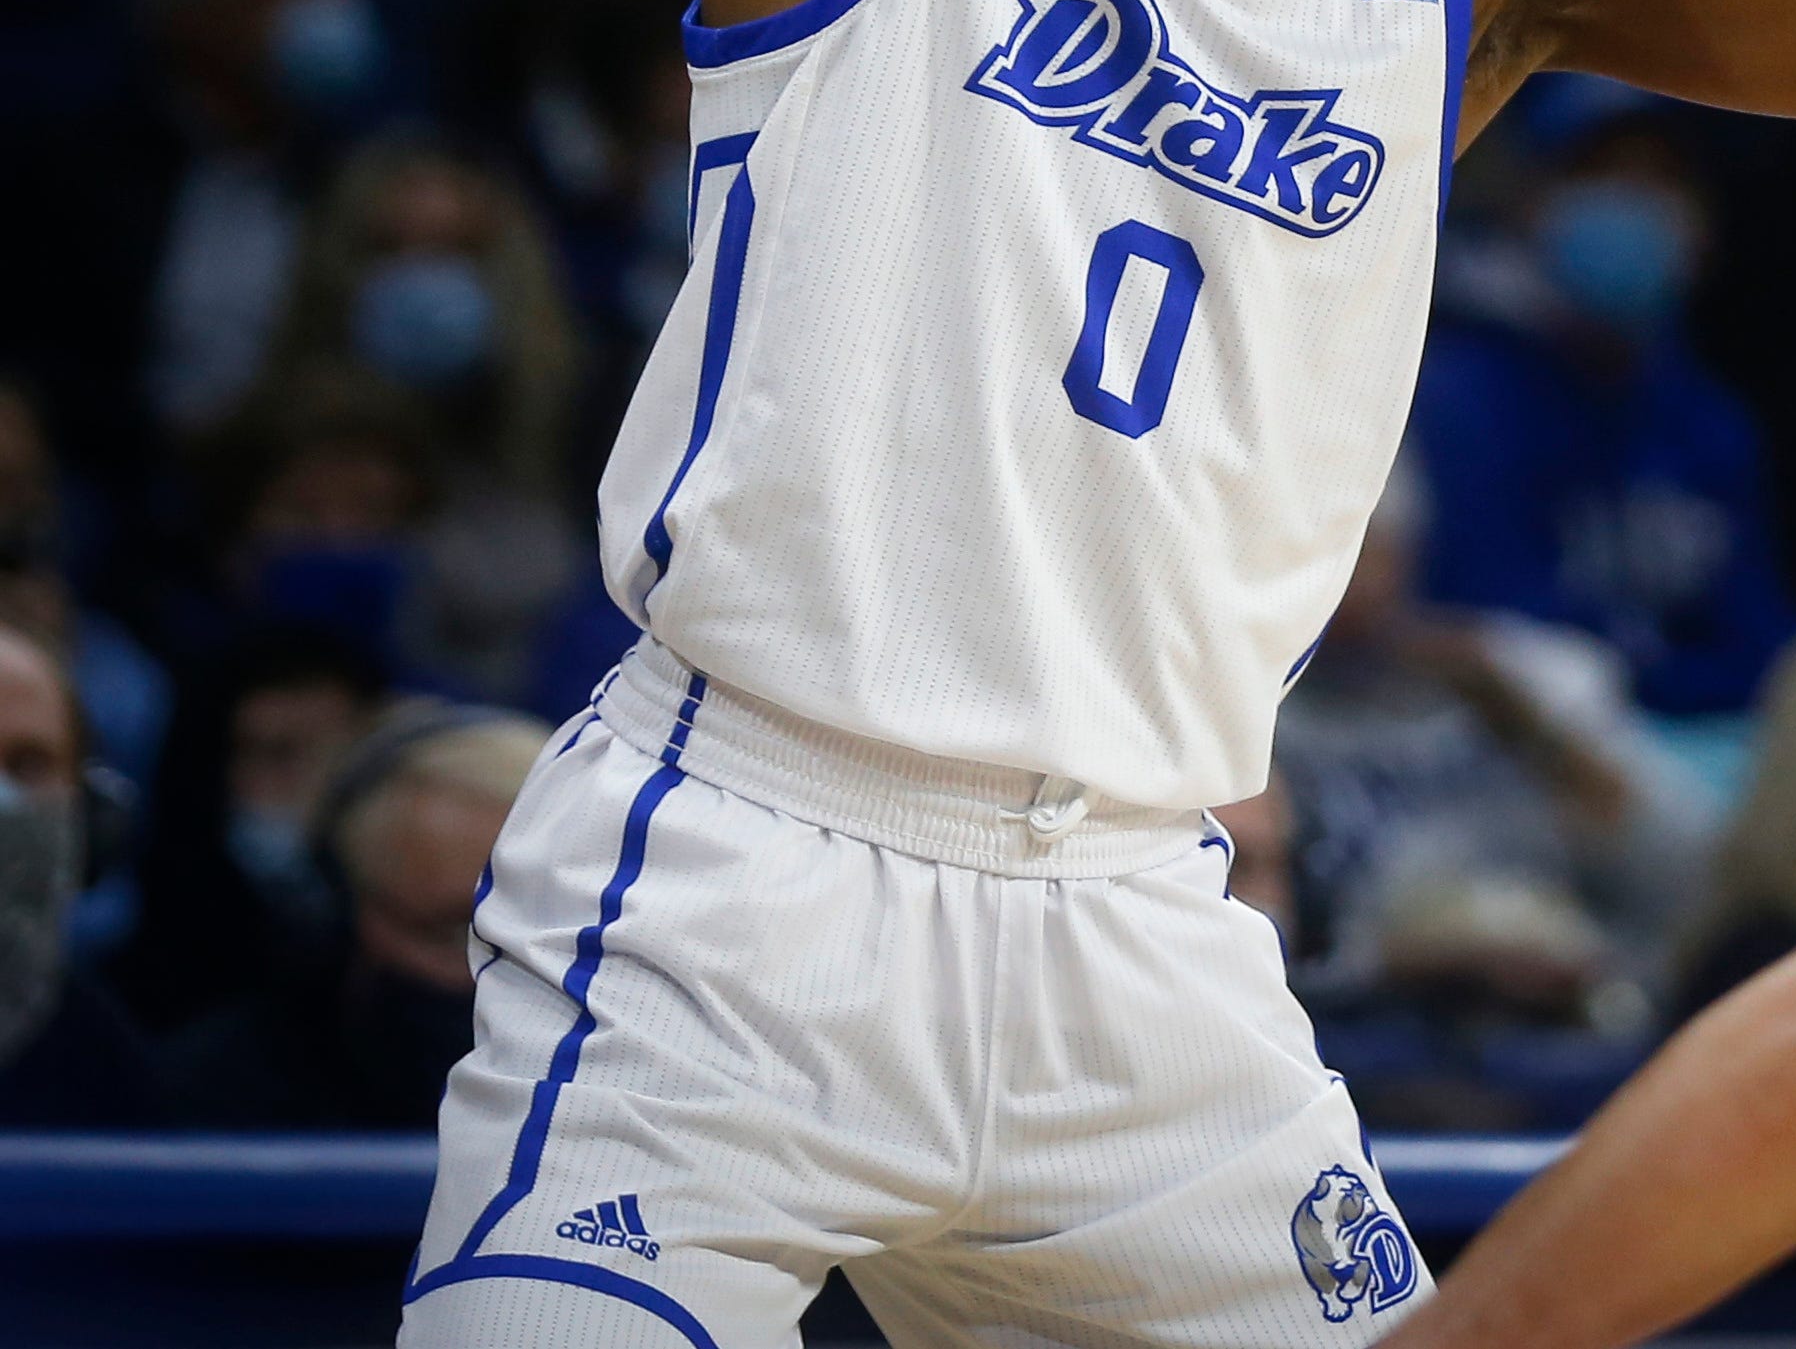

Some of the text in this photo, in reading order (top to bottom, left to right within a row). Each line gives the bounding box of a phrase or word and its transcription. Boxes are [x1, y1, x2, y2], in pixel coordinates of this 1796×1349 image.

[1061, 218, 1205, 439] 0
[555, 1221, 661, 1261] adidas
[1351, 1210, 1418, 1315] D
